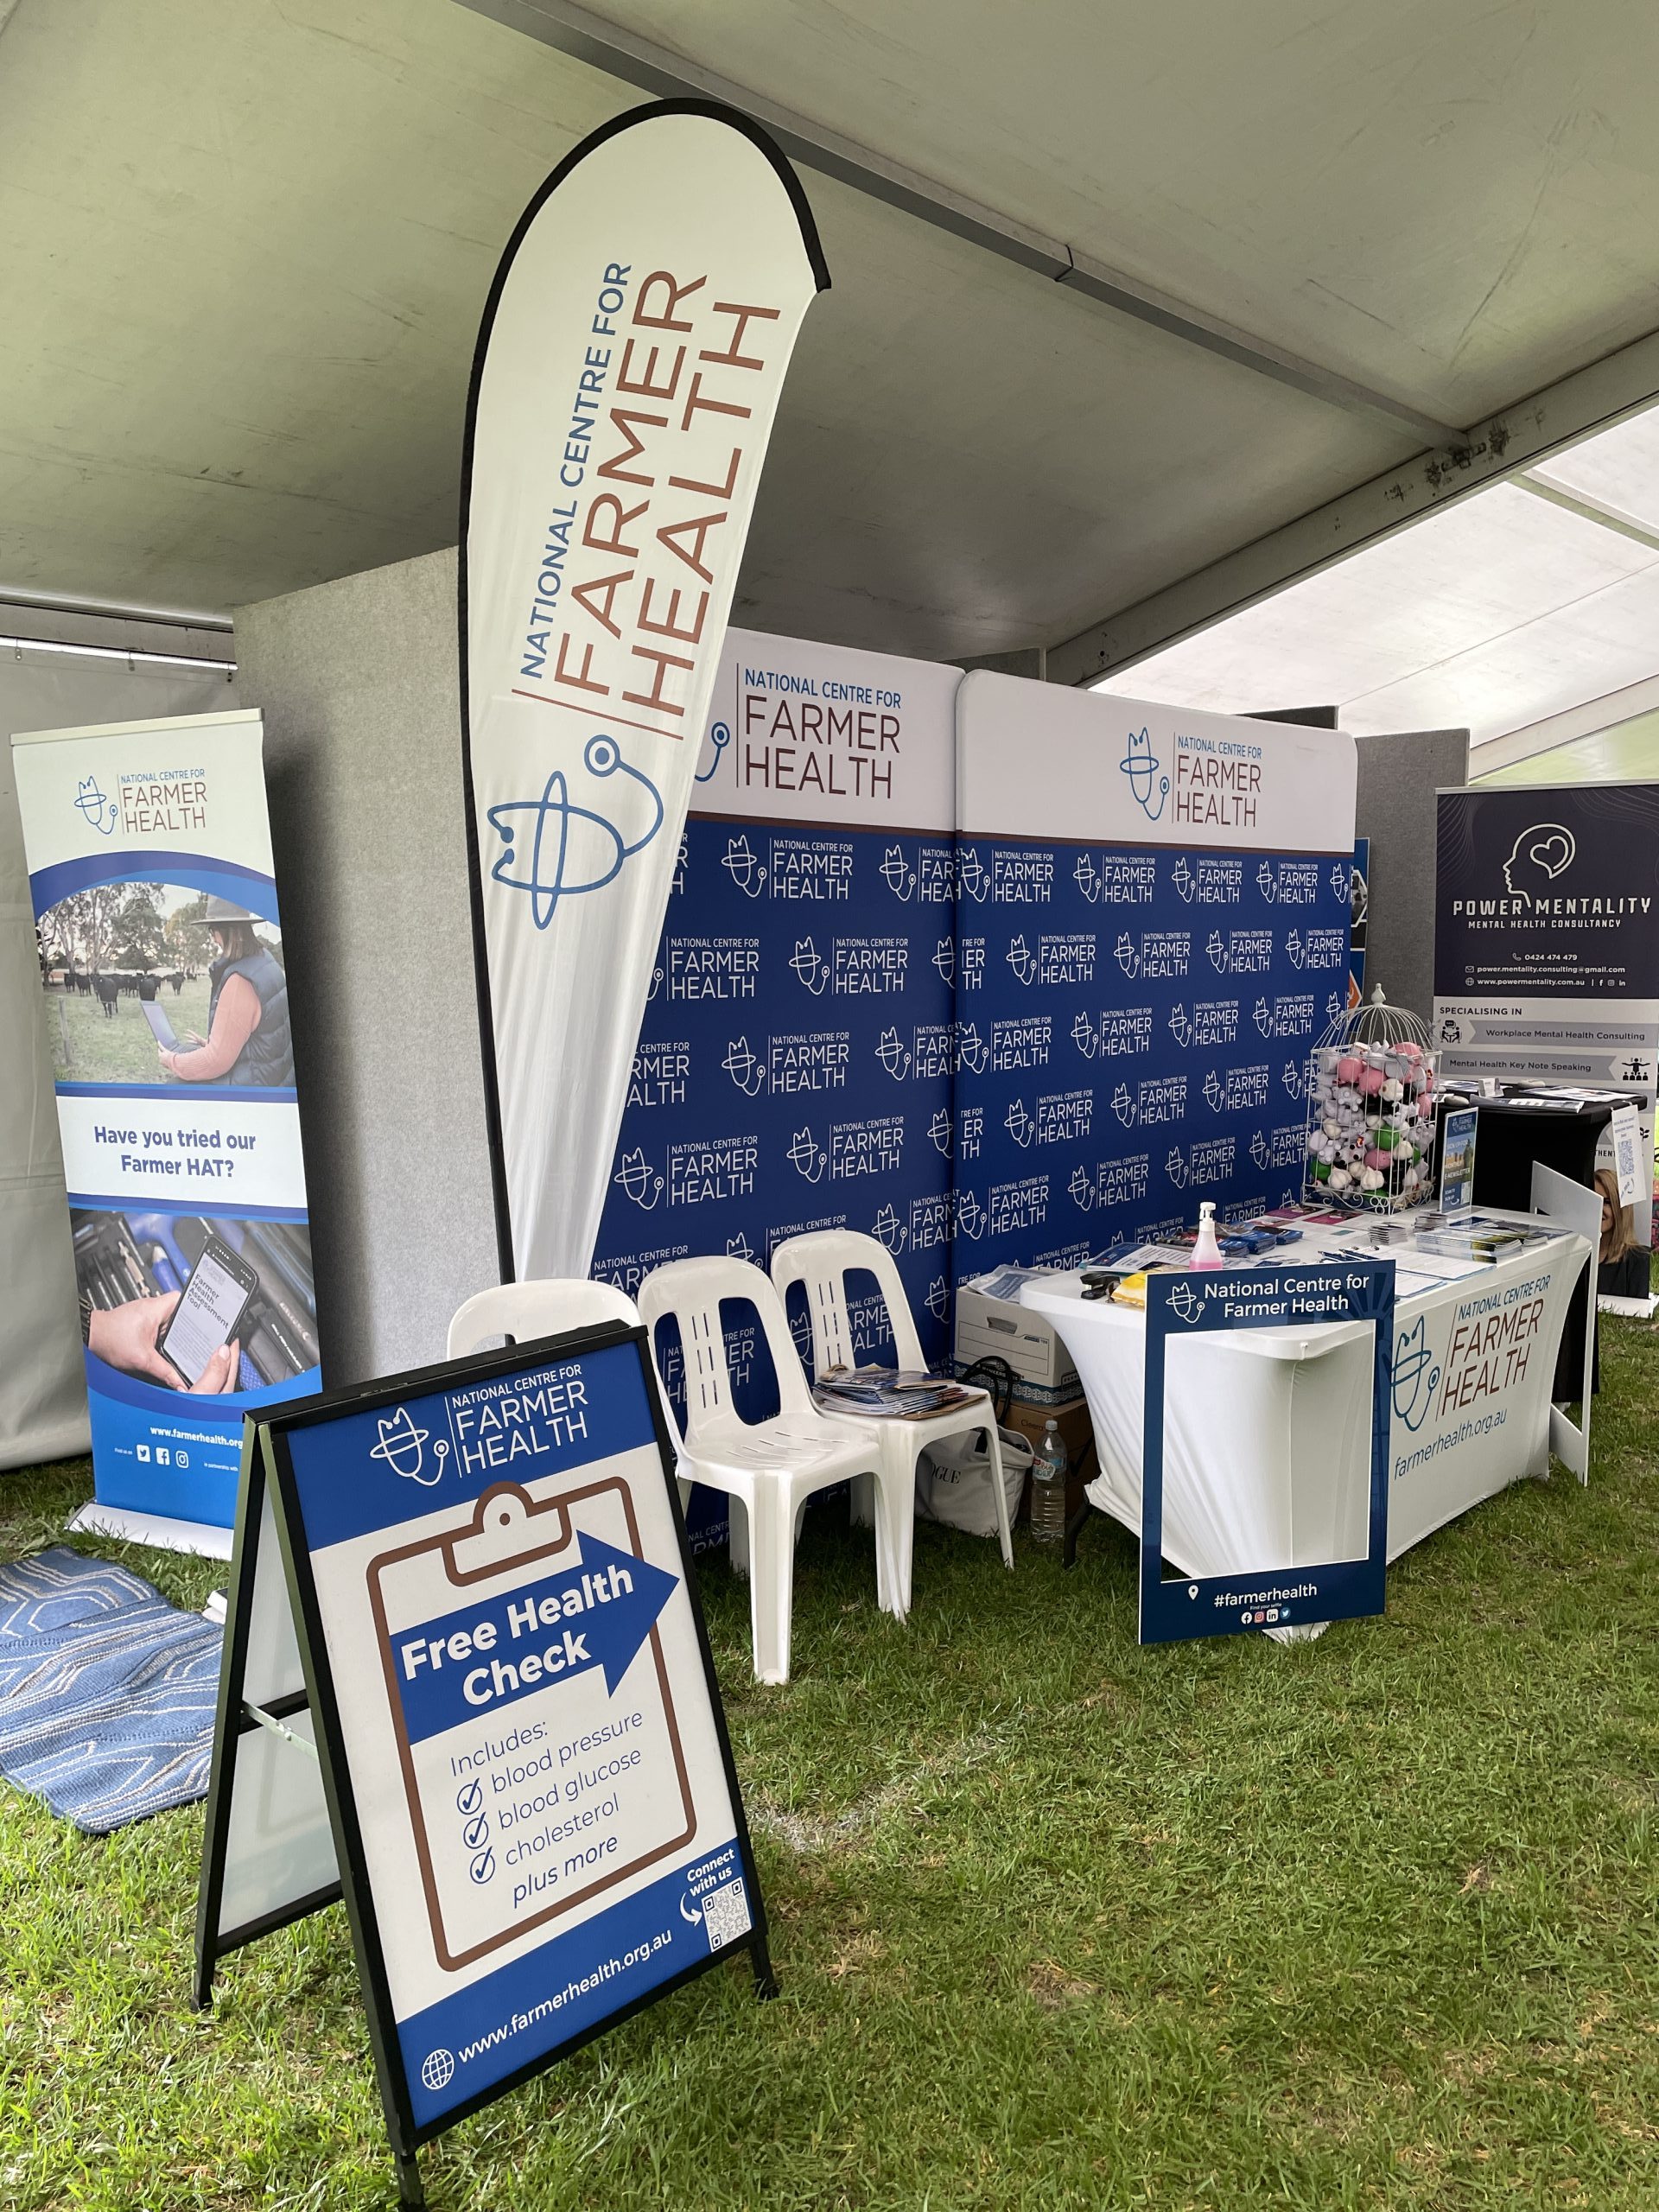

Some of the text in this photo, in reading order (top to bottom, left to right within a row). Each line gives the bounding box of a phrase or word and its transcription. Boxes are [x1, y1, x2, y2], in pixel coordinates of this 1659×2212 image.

[520, 263, 632, 679] NATIONAL CENTRE FOR
[554, 270, 708, 696] FARMER
[622, 302, 781, 716] HEALTH
[746, 668, 900, 709] NATIONAL CENTRE FOR
[747, 695, 899, 753] FARMER
[1178, 735, 1262, 760] NATIONAL CENTRE FOR
[121, 768, 205, 784] NATIONAL CENTRE FOR
[746, 744, 892, 798] HEALTH
[1178, 754, 1261, 792] FARMER
[123, 782, 207, 808] FARMER
[125, 806, 206, 833] HEALTH
[1177, 791, 1255, 827] HEALTH
[773, 840, 853, 853] NATIONAL CENTRE FOR
[995, 851, 1022, 860] NATIONAL
[774, 852, 853, 876] FARMER
[995, 861, 1053, 881] FARMER
[774, 876, 849, 899] HEALTH
[995, 883, 1050, 902] HEALTH
[1453, 898, 1650, 915] POWER MENTALITY
[1468, 920, 1505, 929] MENTAL
[1551, 919, 1620, 928] CONSULTANCY
[671, 938, 760, 948] NATIONAL CENTRE FOR
[836, 938, 869, 947] NATIONAL
[870, 938, 894, 947] CENTRE
[1041, 944, 1096, 963] FARMER
[671, 951, 759, 973] FARMER
[836, 950, 907, 969] FARMER
[836, 972, 904, 994] HEALTH
[1041, 963, 1092, 984] HEALTH
[672, 976, 754, 1000] HEALTH
[1196, 1009, 1238, 1027] FARMER
[1440, 1007, 1508, 1015] SPECIALISING
[772, 1032, 849, 1045] NATIONAL CENTRE FOR
[1195, 1027, 1236, 1046] HEALTH
[1597, 1032, 1644, 1040] Consulting
[772, 1044, 849, 1069] FARMER
[1510, 1061, 1526, 1070] Key
[1551, 1063, 1591, 1072] Speaking
[772, 1066, 844, 1093] HEALTH
[1162, 1077, 1178, 1085] CENTRE
[1141, 1085, 1186, 1106] FARMER
[833, 1116, 904, 1134] NATIONAL CENTRE FOR
[1140, 1103, 1184, 1125] HEALTH
[94, 1126, 256, 1150] Have you tried our
[671, 1135, 758, 1154] NATIONAL CENTRE FOR
[833, 1128, 903, 1156] FARMER
[121, 1154, 234, 1177] Farmer HAT?
[672, 1148, 758, 1179] FARMER
[833, 1149, 899, 1179] HEALTH
[671, 1172, 753, 1205] HEALTH
[192, 1281, 214, 1305] Health
[195, 1274, 219, 1300] Farmer
[1205, 1274, 1370, 1299] National Centre for
[1459, 1275, 1551, 1320] NATIONAL CENTRE FOR
[187, 1294, 200, 1310] Tool
[189, 1287, 229, 1329] Assessment
[1224, 1294, 1348, 1318] Farmer Health
[1449, 1299, 1544, 1368] FARMER
[452, 1364, 582, 1408] NATIONAL CENTRE FOR
[1441, 1343, 1530, 1415] HEALTH
[454, 1382, 588, 1440] FARMER
[462, 1411, 588, 1474] HEALTH
[1395, 1408, 1507, 1478] farmerhealth.org.au
[1214, 1584, 1317, 1607] #farmerhealth
[401, 1566, 633, 1681] Free Health
[463, 1633, 592, 1705] Check
[451, 1721, 548, 1777] Includes:
[492, 1713, 642, 1794] blood pressure
[499, 1751, 640, 1830] blood glucose
[506, 1796, 619, 1865] cholesterol
[514, 1837, 617, 1909] plus more
[687, 1848, 734, 1882] Connect
[690, 1867, 732, 1895] with us
[458, 1929, 671, 2063] www.farmerhealth.org.au
